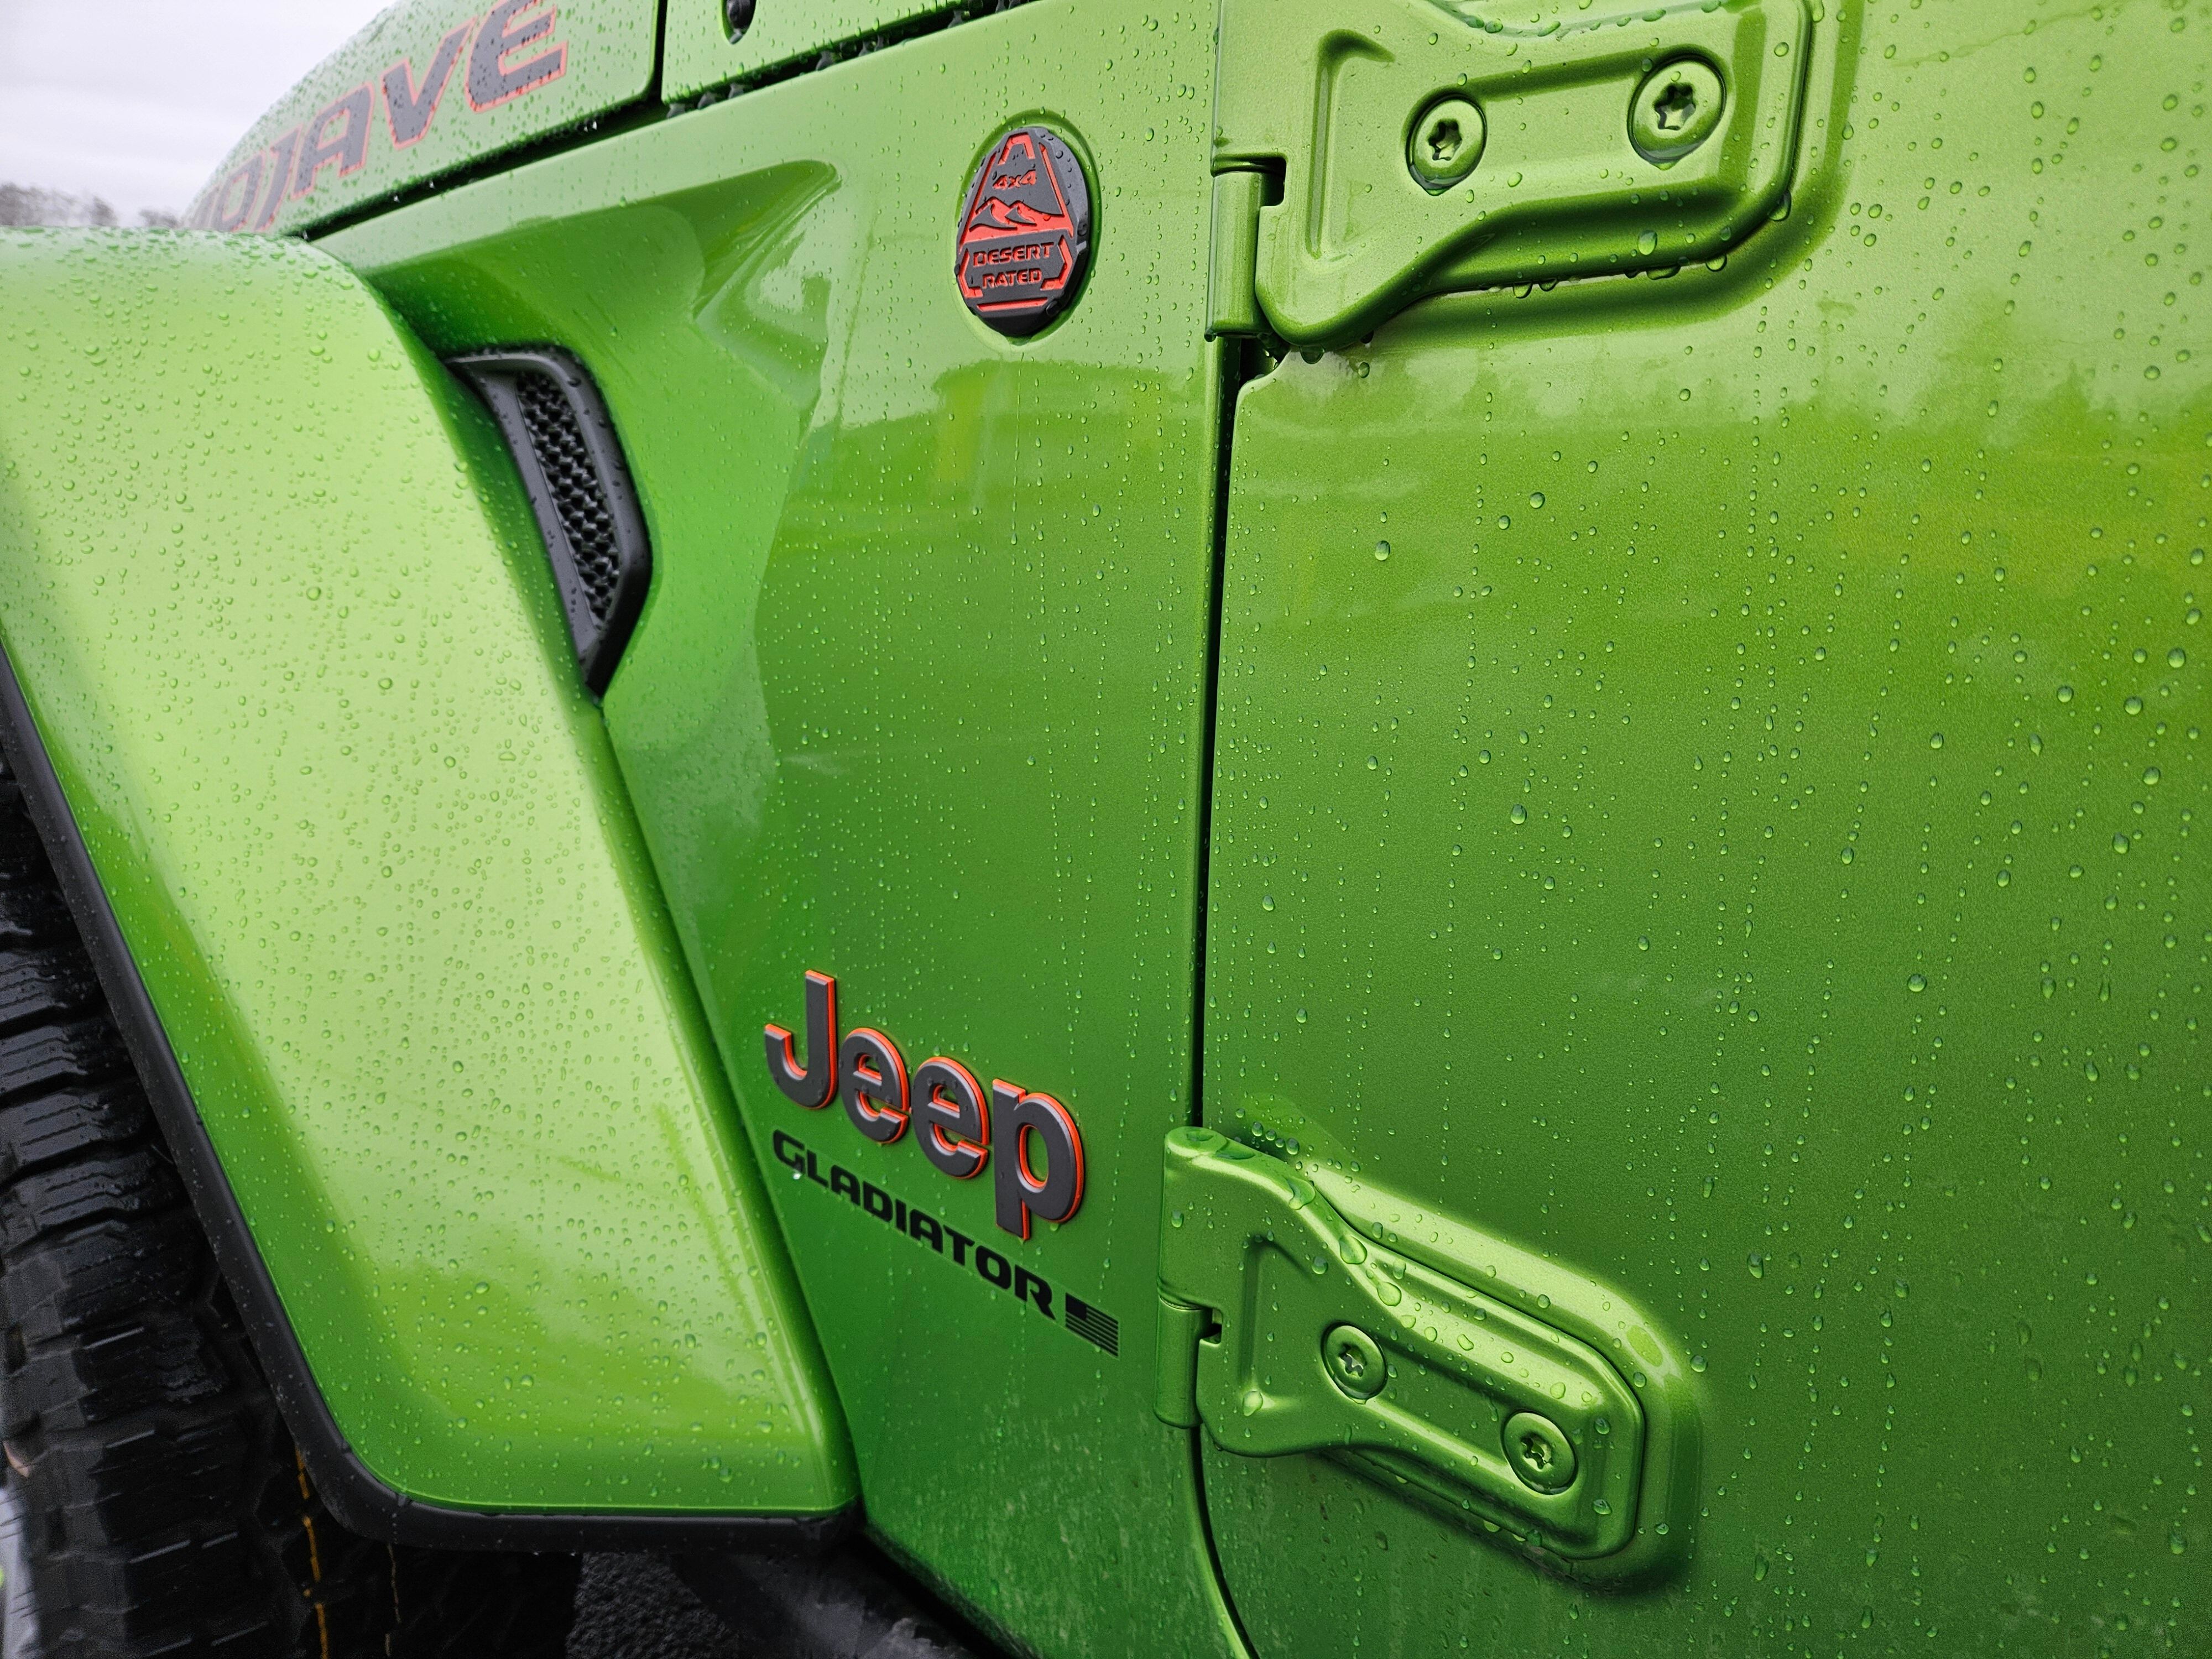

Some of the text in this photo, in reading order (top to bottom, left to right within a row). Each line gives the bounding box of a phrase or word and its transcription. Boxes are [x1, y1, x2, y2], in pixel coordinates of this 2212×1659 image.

[973, 242, 1054, 267] DESERT
[982, 268, 1042, 289] RATED
[764, 969, 1084, 1240] Jeep
[773, 1129, 1057, 1321] GLADIATOR
